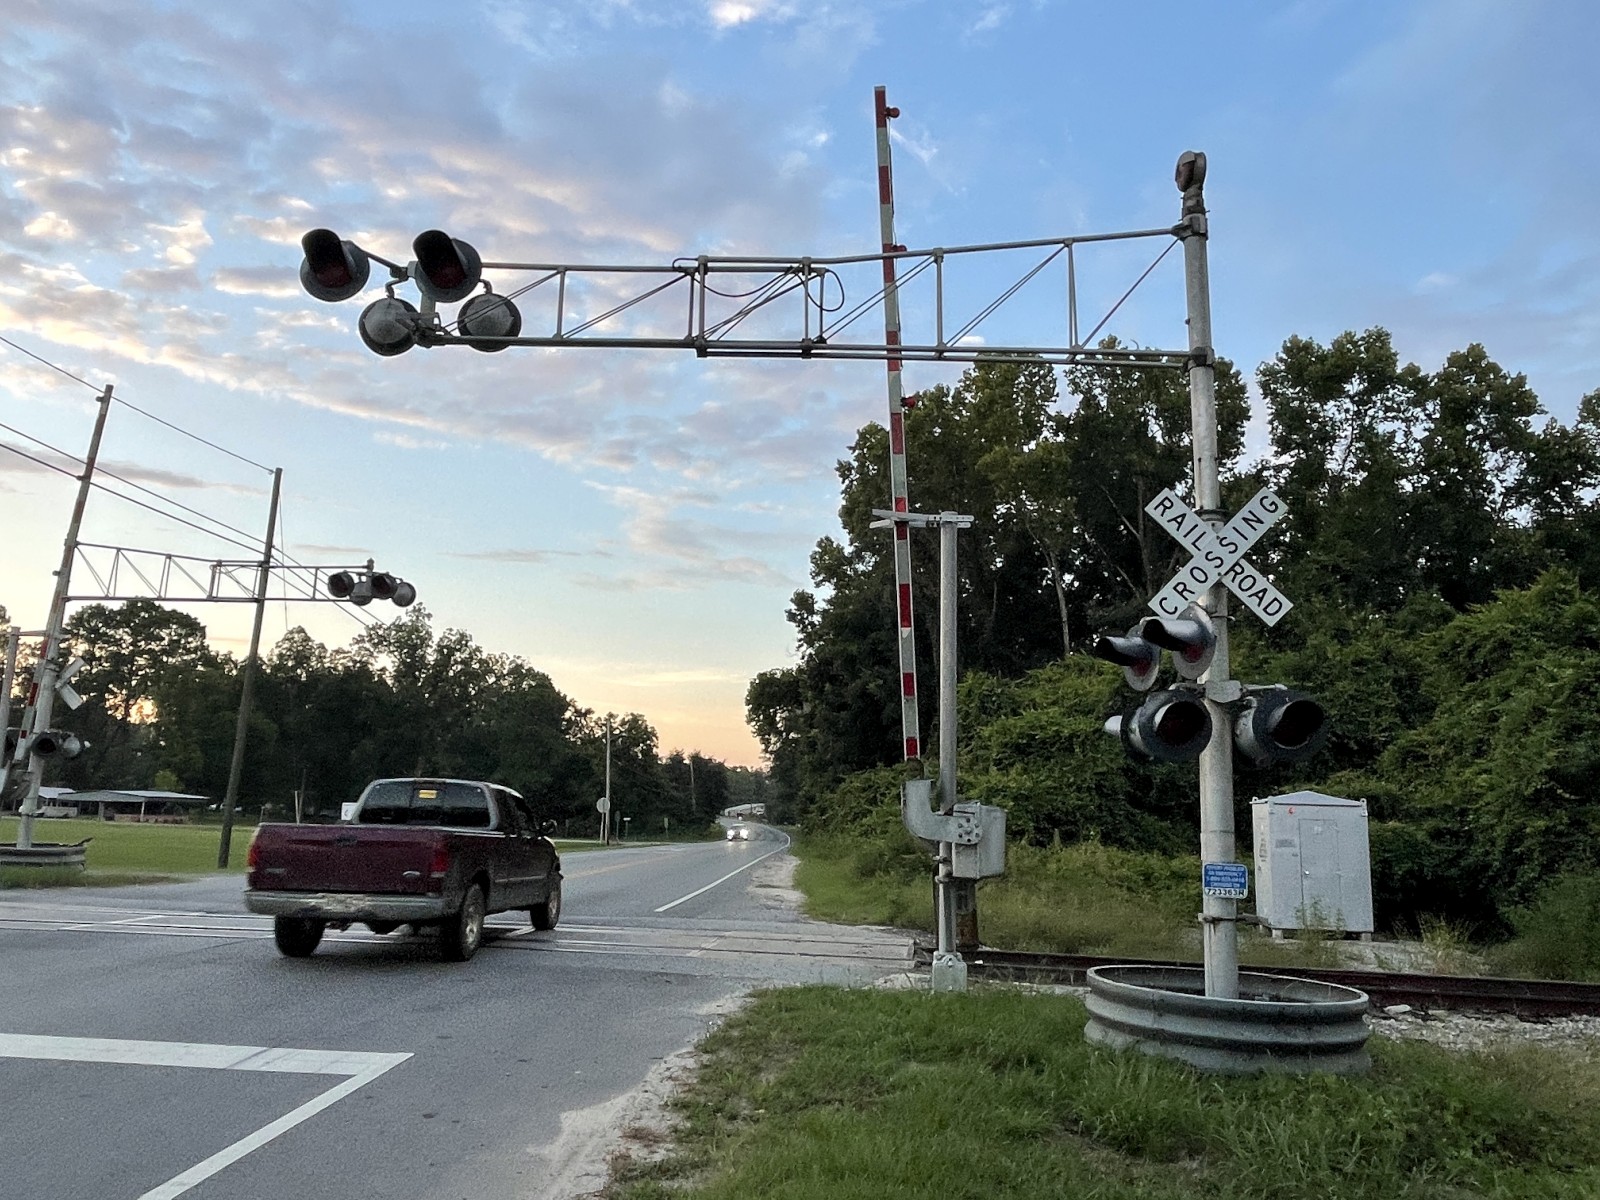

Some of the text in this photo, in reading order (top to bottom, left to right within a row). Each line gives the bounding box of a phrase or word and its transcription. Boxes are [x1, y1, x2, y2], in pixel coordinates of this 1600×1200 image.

[1154, 496, 1283, 617] RAIL ROAD
[1158, 495, 1279, 615] CROSSING
